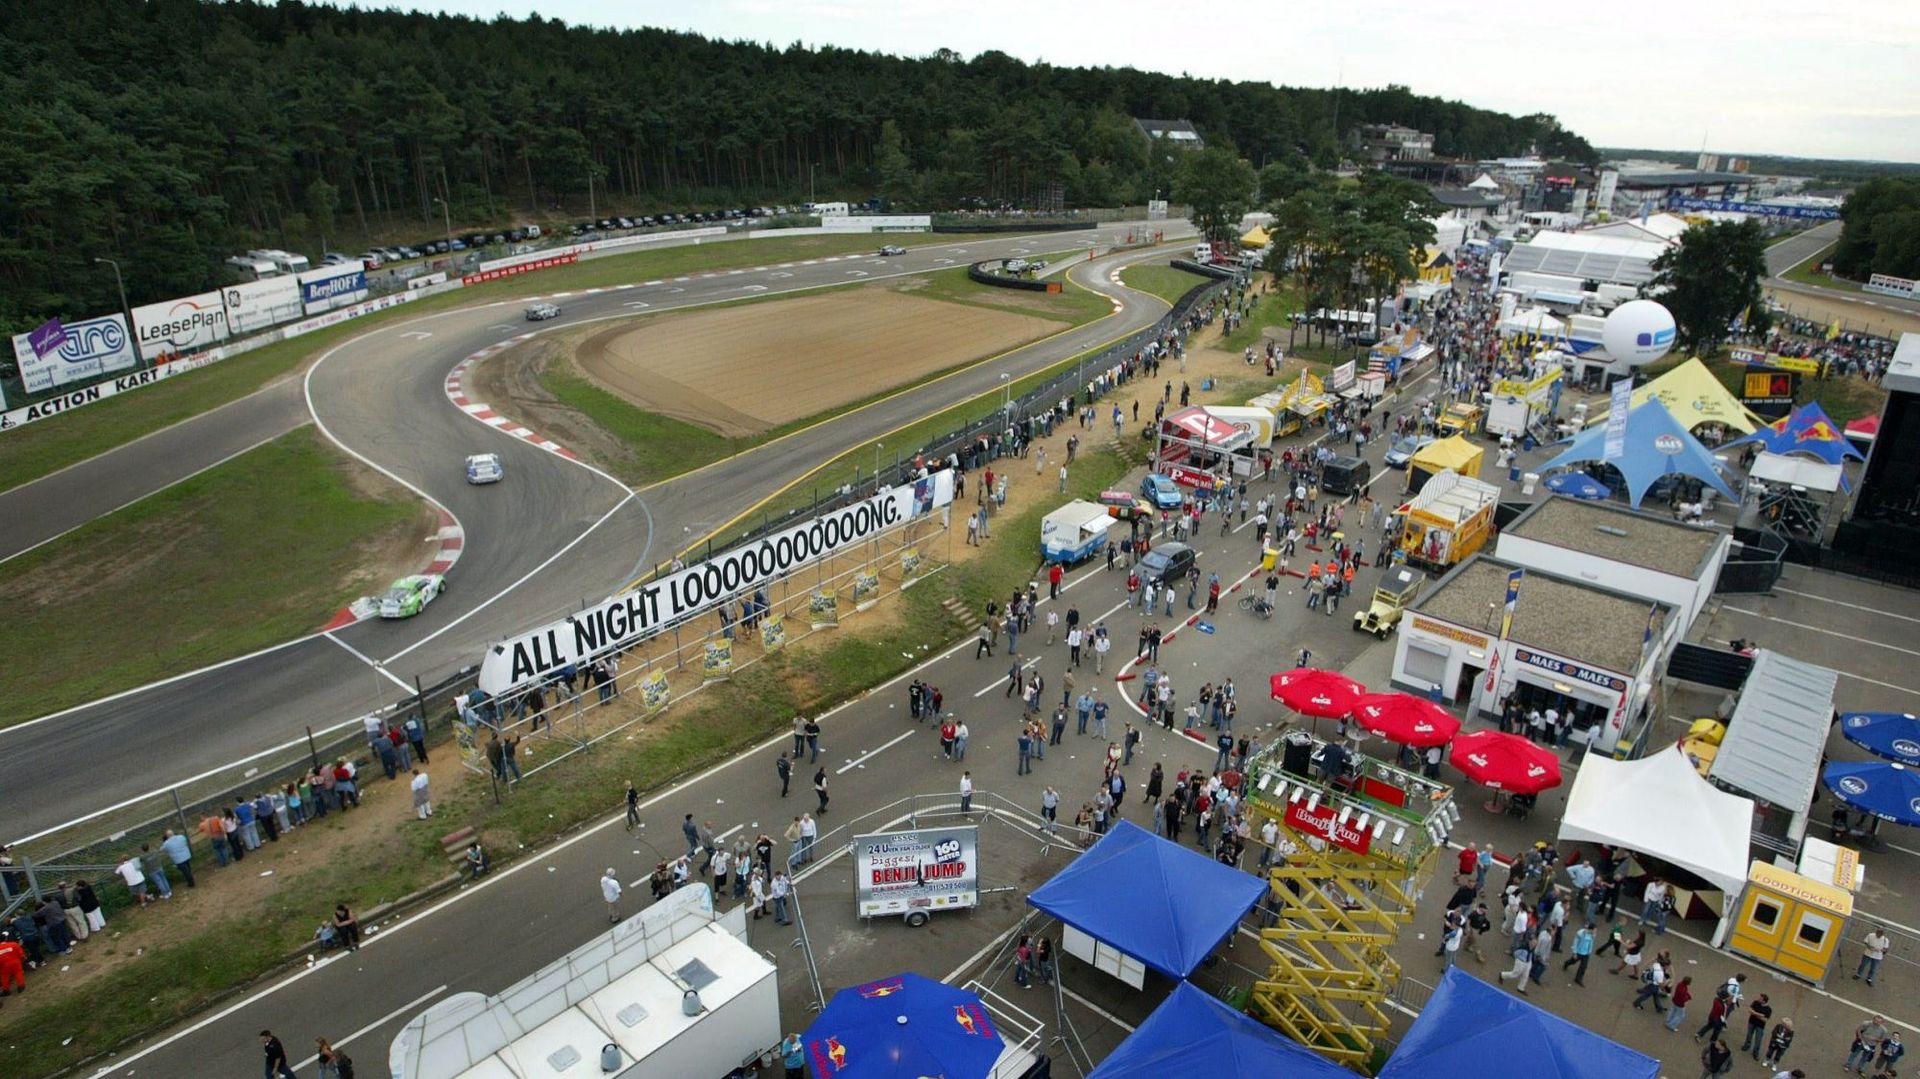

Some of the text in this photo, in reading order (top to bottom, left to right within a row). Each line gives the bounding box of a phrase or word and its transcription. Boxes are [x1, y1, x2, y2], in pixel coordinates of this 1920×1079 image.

[310, 274, 360, 298] BergHOFF
[140, 311, 224, 342] LeasePlan
[27, 368, 159, 421] ACTION KART
[510, 494, 902, 684] ALL NIGHT LOOOOOOOOOOONG.
[1530, 655, 1611, 686] MAES MAES
[868, 845, 880, 855] 24
[871, 855, 915, 867] biggest
[935, 840, 959, 855] 160
[872, 862, 967, 884] BENJI JUMP
[1756, 873, 1844, 911] FOODTICKETS
